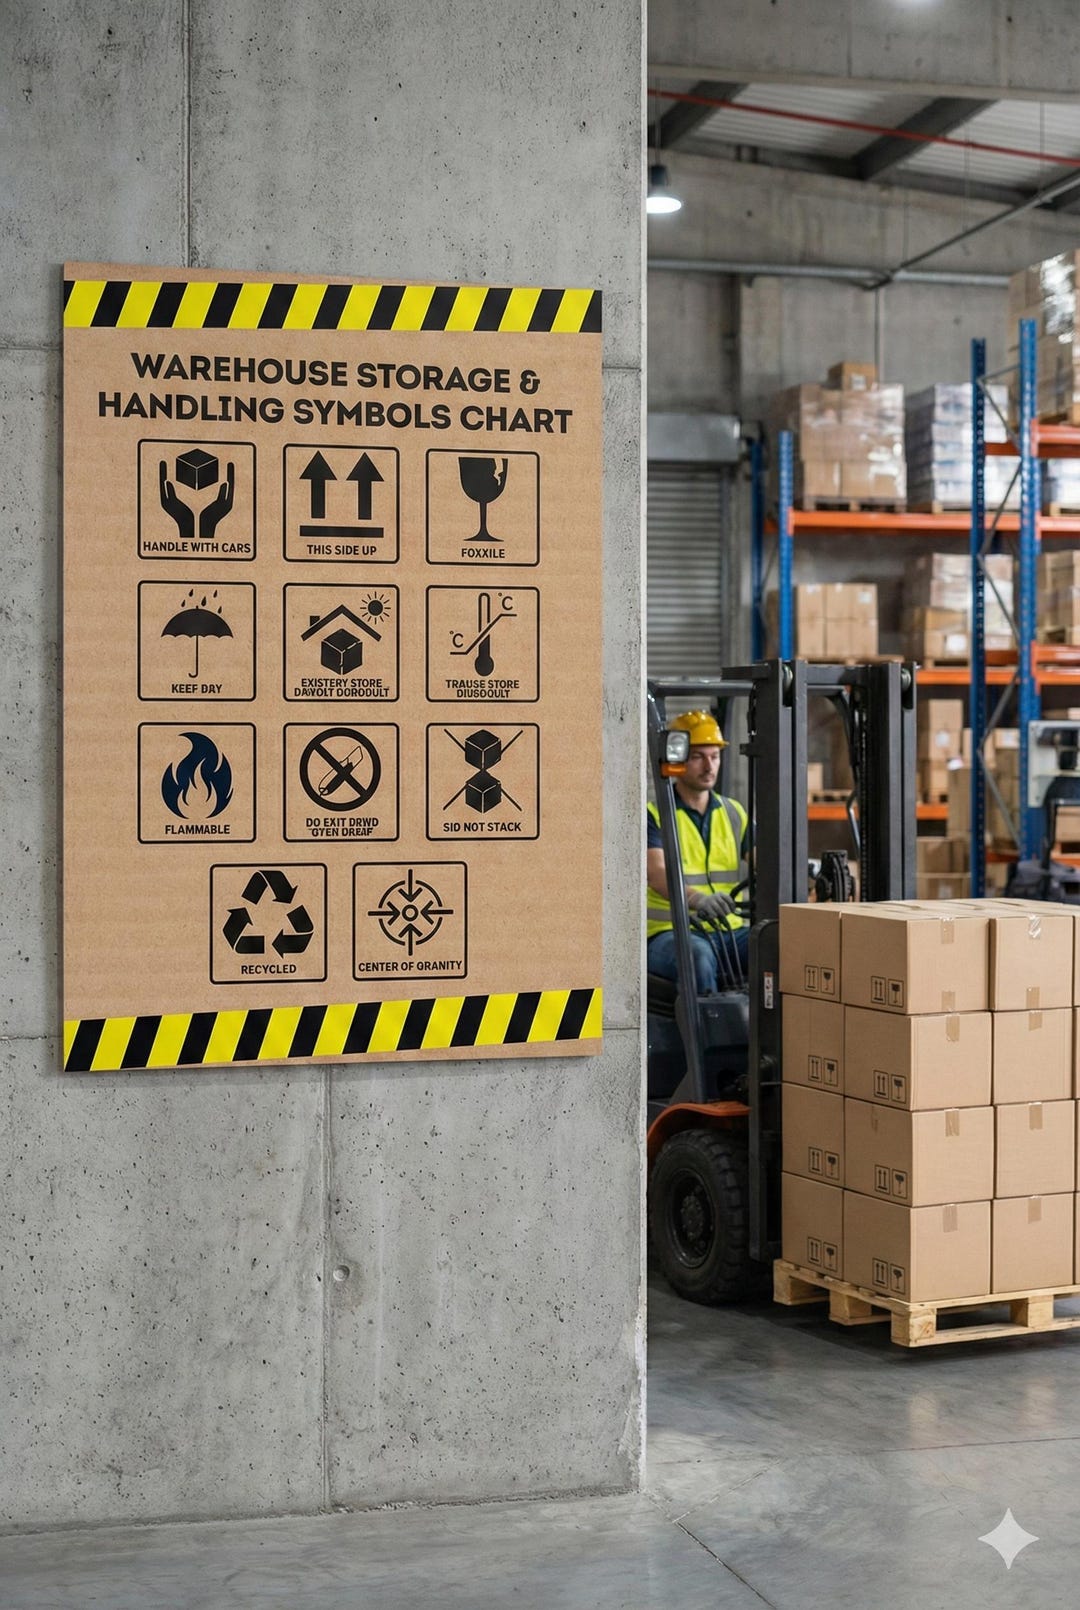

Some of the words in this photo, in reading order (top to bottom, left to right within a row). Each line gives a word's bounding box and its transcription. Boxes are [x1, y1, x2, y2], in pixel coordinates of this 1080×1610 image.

[131, 353, 347, 386] WAREHOUSE
[357, 363, 510, 393] STORAGE
[520, 370, 540, 394] &
[99, 392, 284, 423] HANDLING
[294, 399, 451, 429] SYMBOLS
[460, 406, 572, 433] CHART
[143, 541, 189, 552] HANDLE
[190, 541, 219, 553] WITH
[221, 542, 252, 554] CARS
[306, 544, 333, 555] THIS
[334, 544, 360, 556] SIDE
[361, 545, 377, 556] UP
[461, 547, 506, 559] FOXXILE
[301, 677, 349, 688] EXISTERY
[350, 678, 383, 688] STORE
[445, 679, 486, 689] TRAUSE
[487, 679, 520, 689] STORE
[305, 817, 321, 828] DO
[323, 817, 347, 828] EXIT
[443, 822, 461, 833] SID
[463, 822, 486, 832] NOT
[487, 821, 522, 832] STACK
[164, 824, 231, 835] FLAMMABLE
[240, 964, 297, 975] RECYCLED
[358, 961, 399, 973] CENTER
[400, 961, 415, 972] OF
